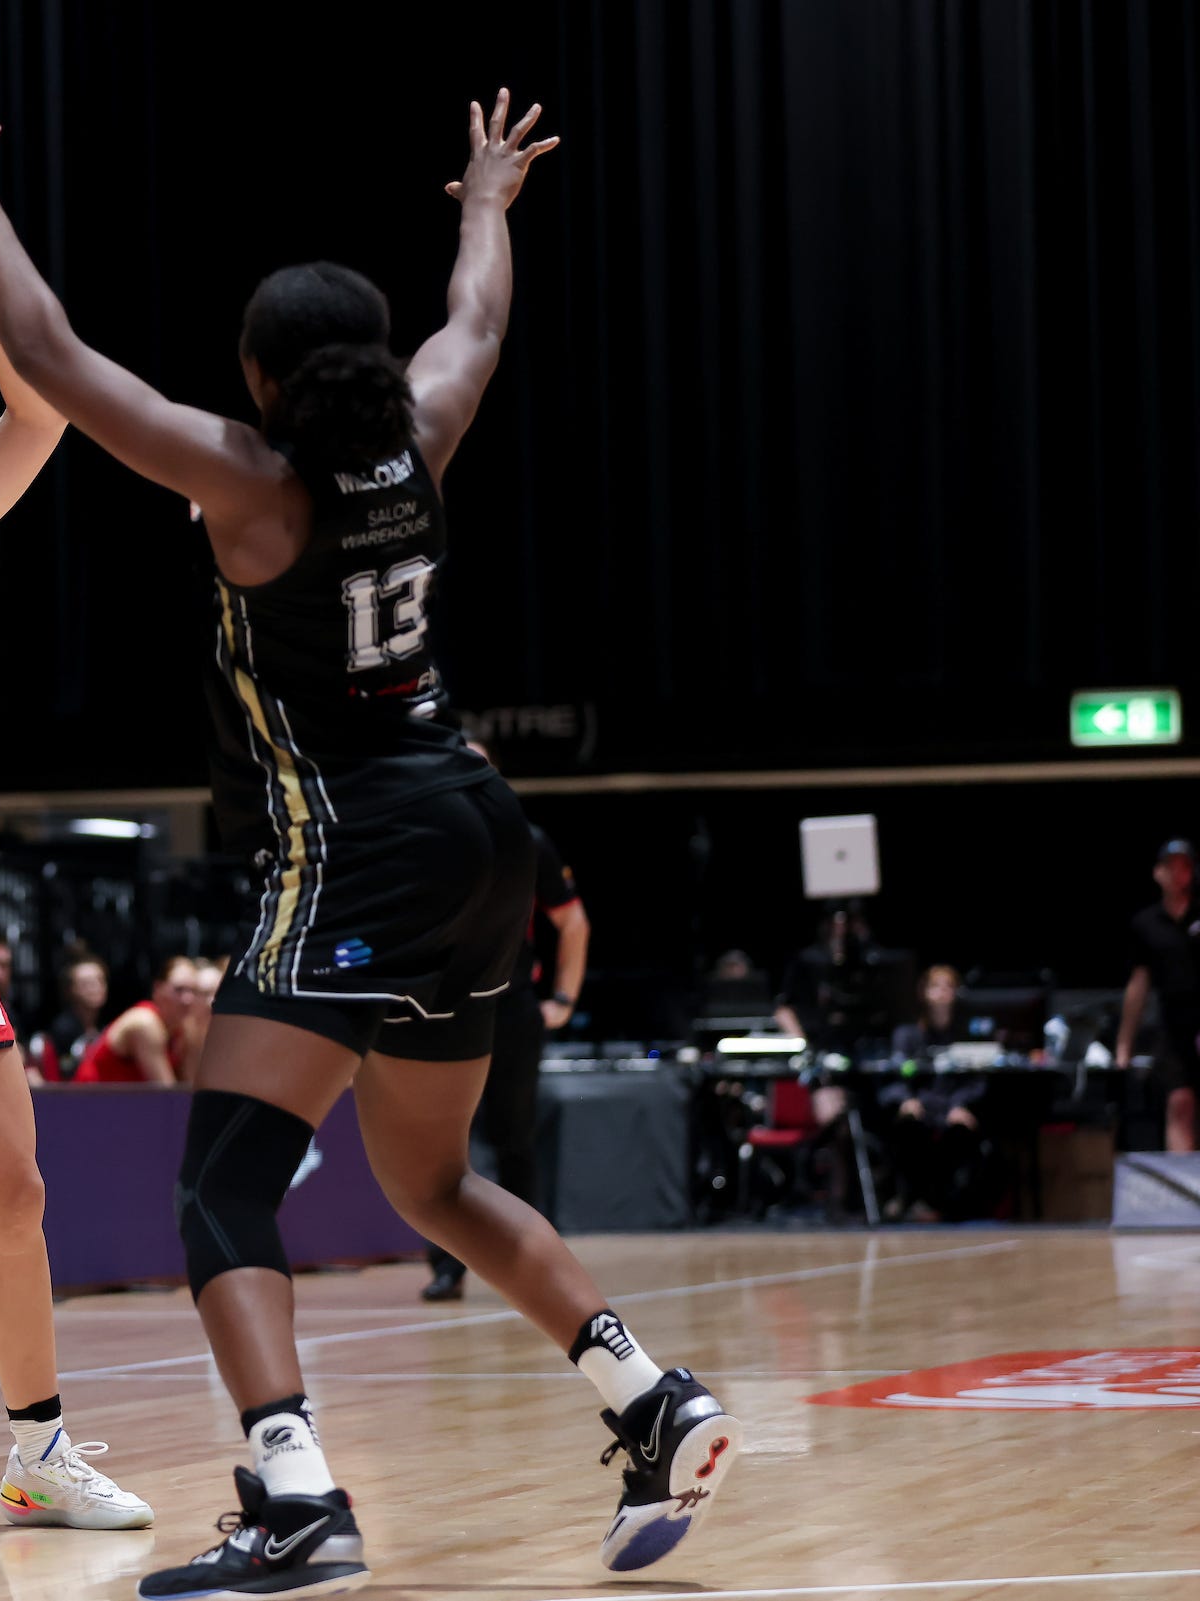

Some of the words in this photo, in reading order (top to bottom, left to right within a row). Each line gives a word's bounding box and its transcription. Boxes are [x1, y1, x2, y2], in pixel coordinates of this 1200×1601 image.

[341, 510, 431, 550] WAREHOUSE
[367, 500, 417, 528] SALON
[341, 554, 437, 673] 13
